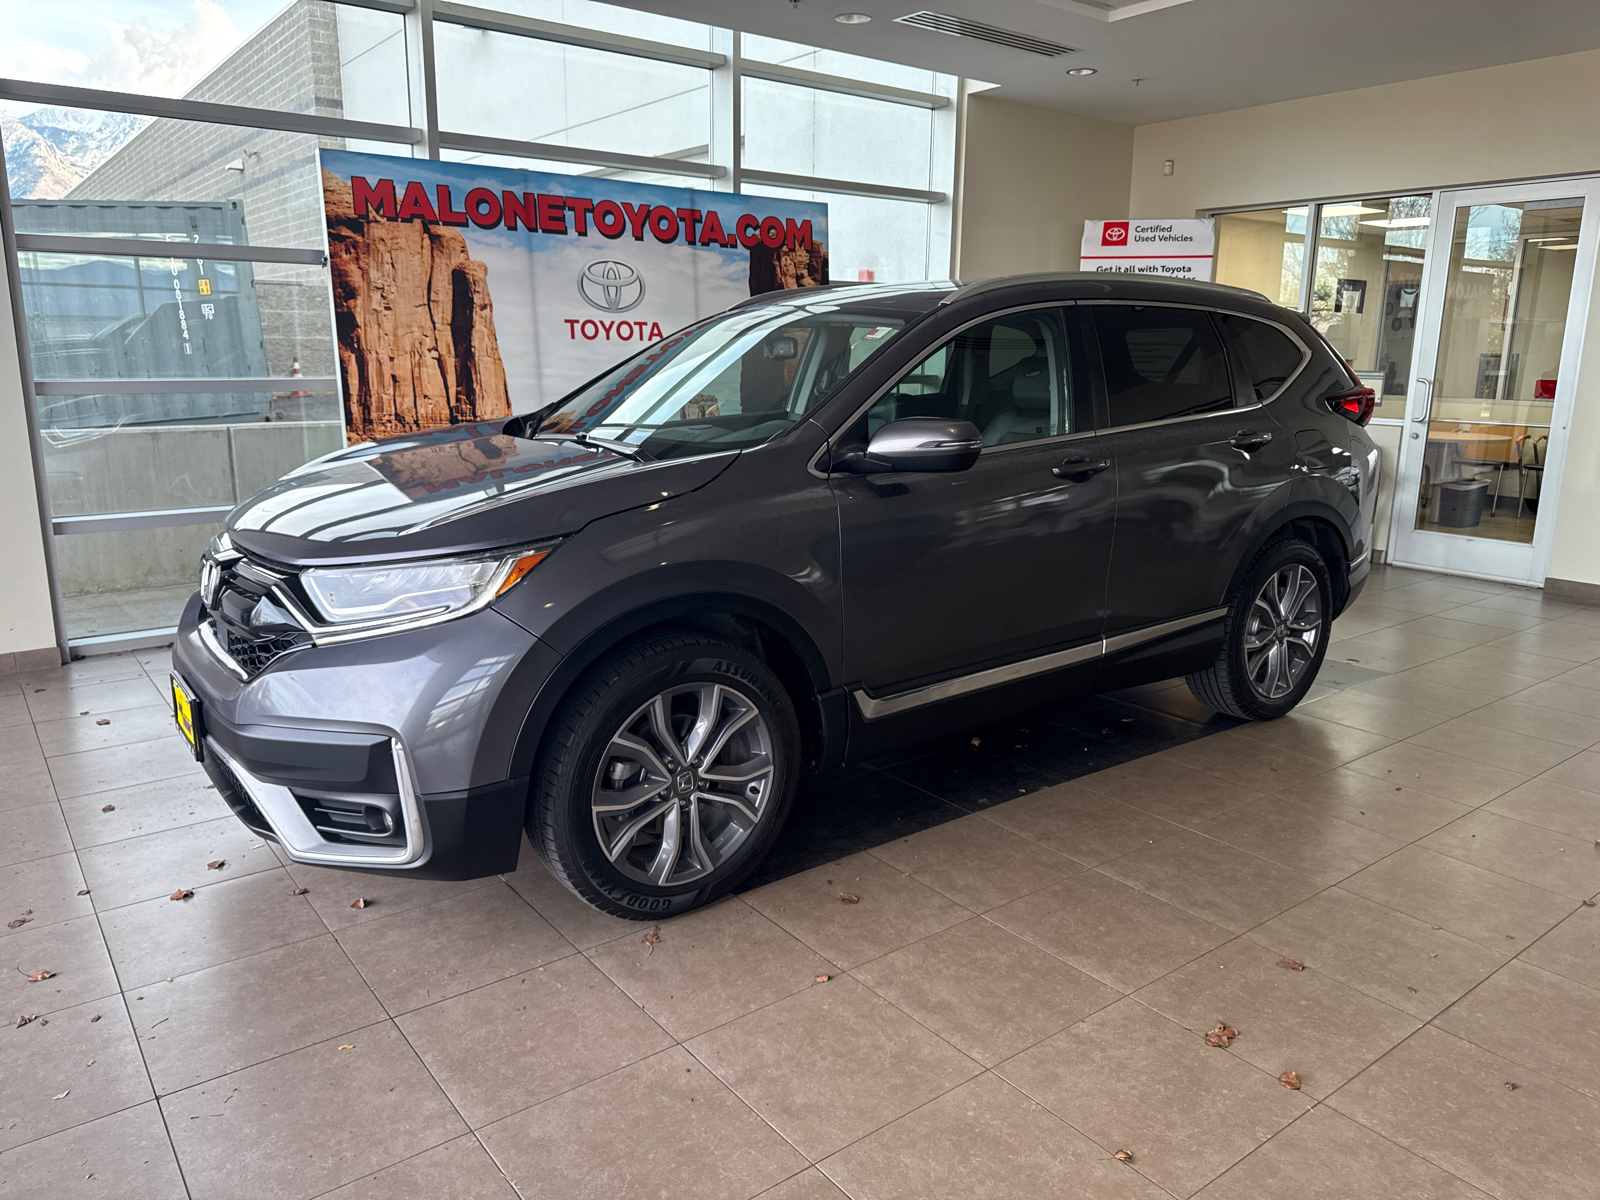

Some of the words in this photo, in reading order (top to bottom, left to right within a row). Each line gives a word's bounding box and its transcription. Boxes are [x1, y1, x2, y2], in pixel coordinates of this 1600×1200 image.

[351, 176, 813, 250] MALONETOYOTA.COM
[1135, 225, 1172, 233] Certified
[1134, 234, 1155, 242] Used
[1158, 234, 1193, 242] Vehicles
[1124, 265, 1136, 273] all
[1138, 265, 1159, 273] with
[1160, 265, 1191, 274] Toyota
[564, 319, 664, 341] TOYOTA
